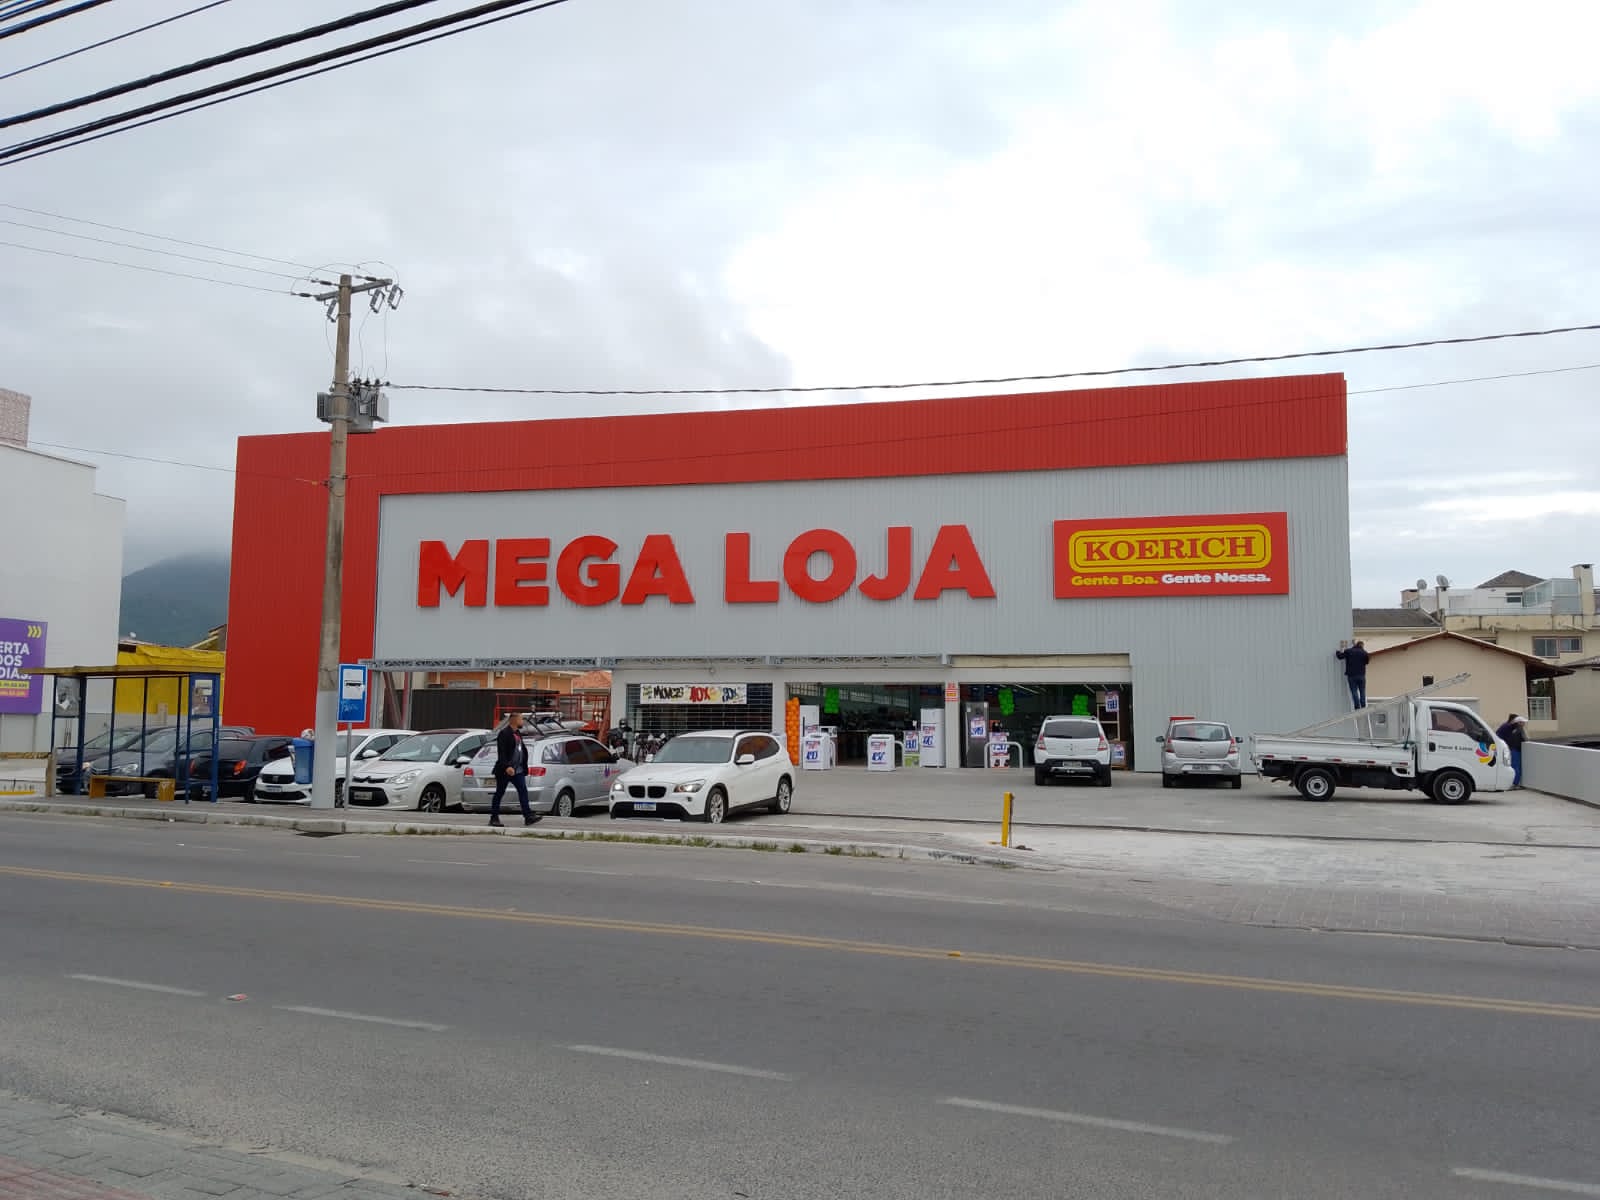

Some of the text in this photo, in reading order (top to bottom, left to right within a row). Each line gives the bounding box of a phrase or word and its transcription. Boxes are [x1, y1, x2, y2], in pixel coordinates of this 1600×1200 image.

[1083, 537, 1256, 561] KOERICH
[417, 525, 997, 608] MEGA LOJA
[1072, 572, 1271, 586] Gente Boa. Gente Nossa.
